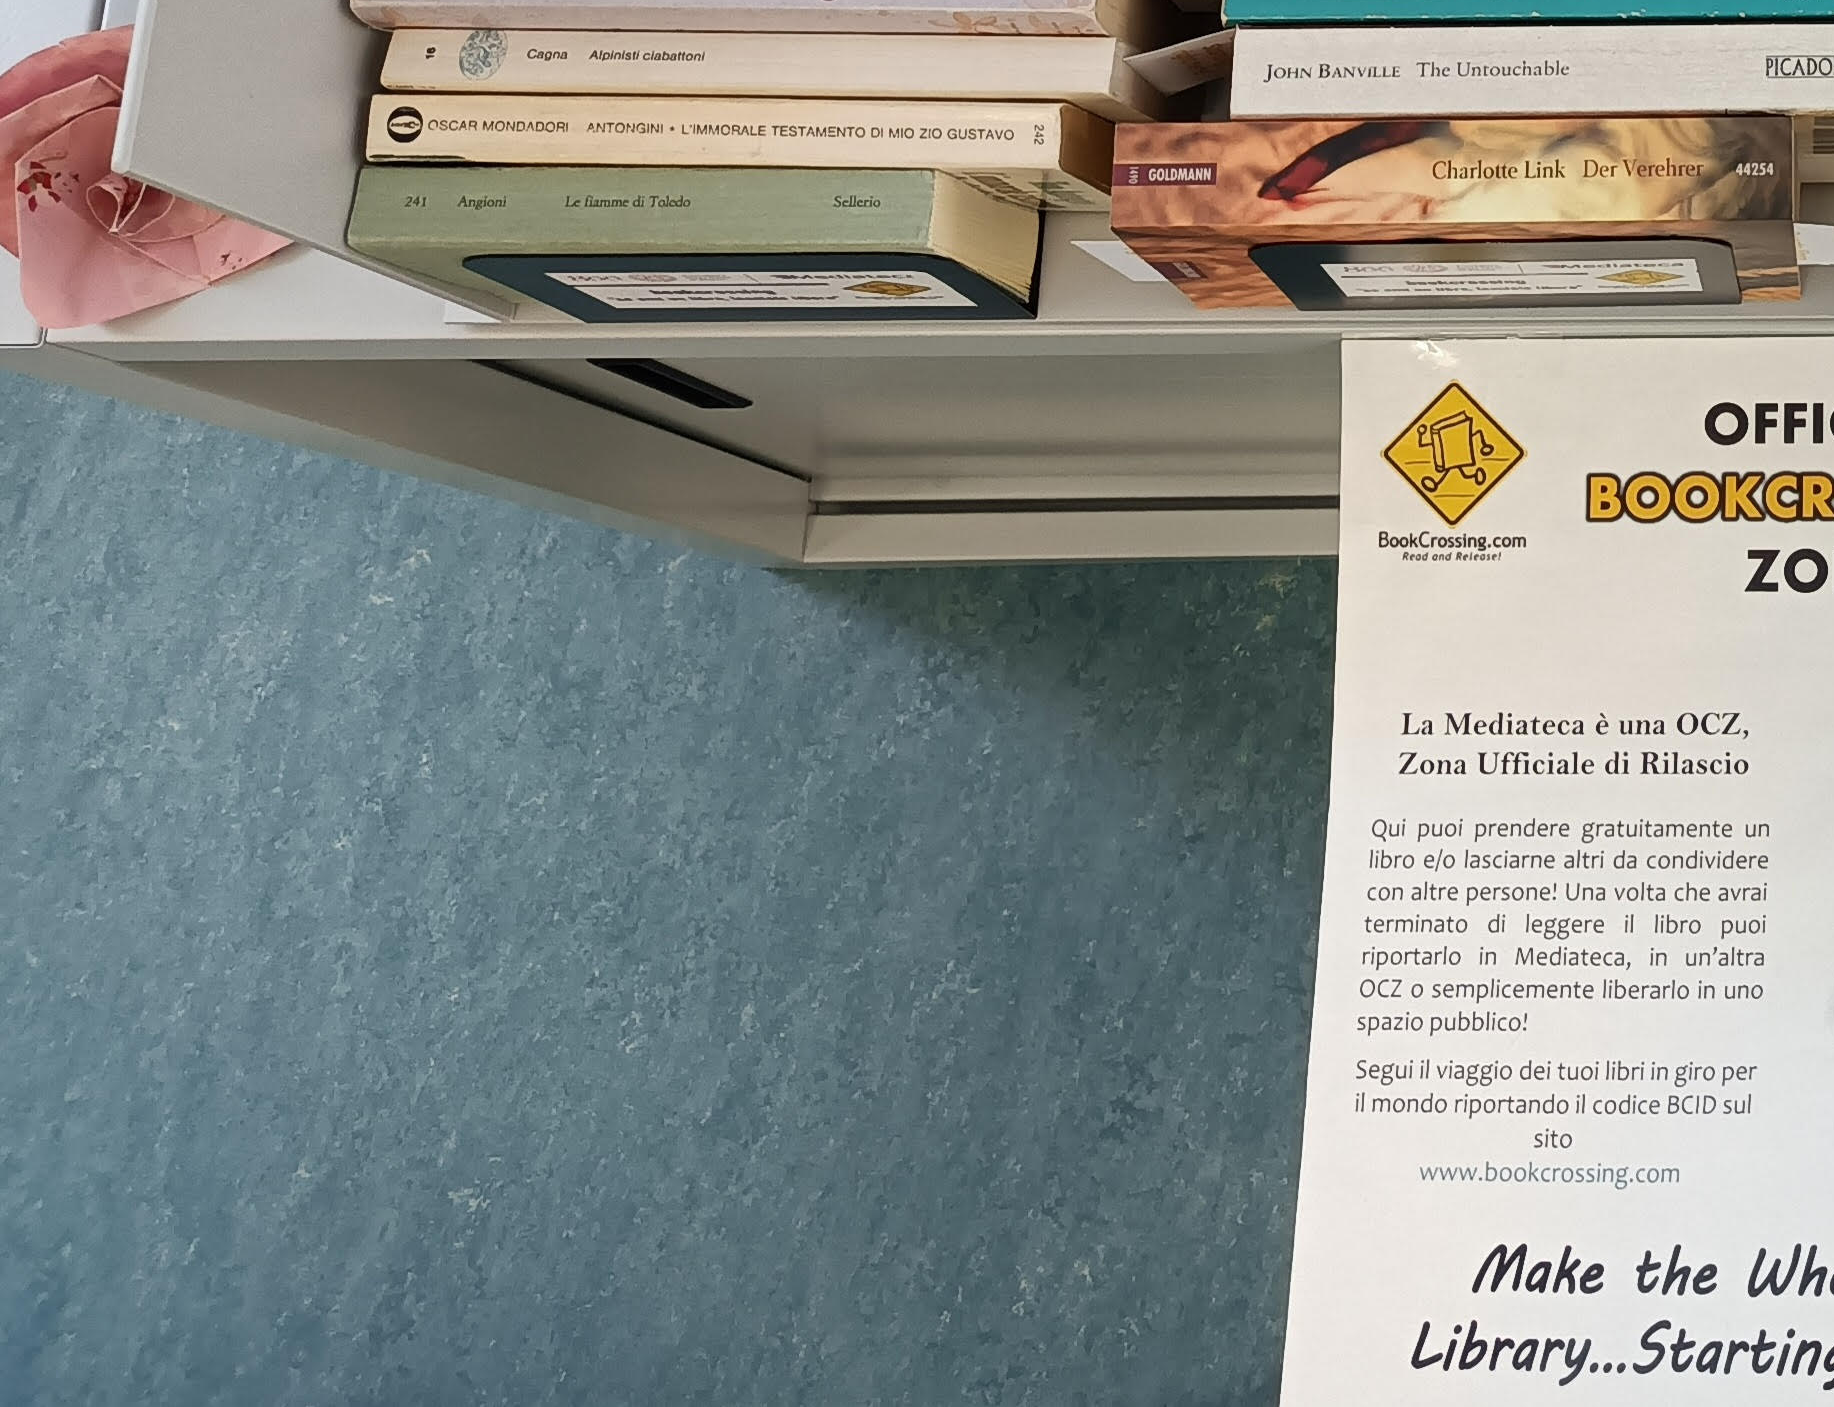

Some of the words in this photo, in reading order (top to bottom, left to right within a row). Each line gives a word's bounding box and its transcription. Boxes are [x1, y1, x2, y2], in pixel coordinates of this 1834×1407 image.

[1147, 167, 1212, 182] GOLDMANN
[1431, 159, 1519, 181] Charlotte
[1524, 158, 1566, 180] Link
[1584, 159, 1618, 178] Der
[1623, 157, 1704, 178] Verehrer
[1735, 162, 1775, 177] 44254
[403, 195, 428, 208] 241
[456, 194, 507, 211] Angioni
[564, 194, 582, 209] Le
[583, 194, 630, 209] fiamme
[631, 194, 646, 209] di
[648, 194, 692, 209] Toledo
[832, 194, 882, 209] Sellerio
[1377, 530, 1527, 553] BookCrossing.com
[1401, 712, 1434, 736] La
[1444, 711, 1585, 736] Mediateca
[1594, 711, 1610, 736] è
[1619, 719, 1666, 736] una
[1675, 711, 1750, 740] OCZ,
[1398, 751, 1467, 776] Zona
[1477, 751, 1595, 776] Ufficiale
[1604, 750, 1630, 776] di
[1640, 751, 1750, 776] Rilascio
[1419, 1160, 1681, 1191] www.bookcrossing.com
[1471, 1242, 1605, 1295] Make
[1635, 1243, 1718, 1297] the
